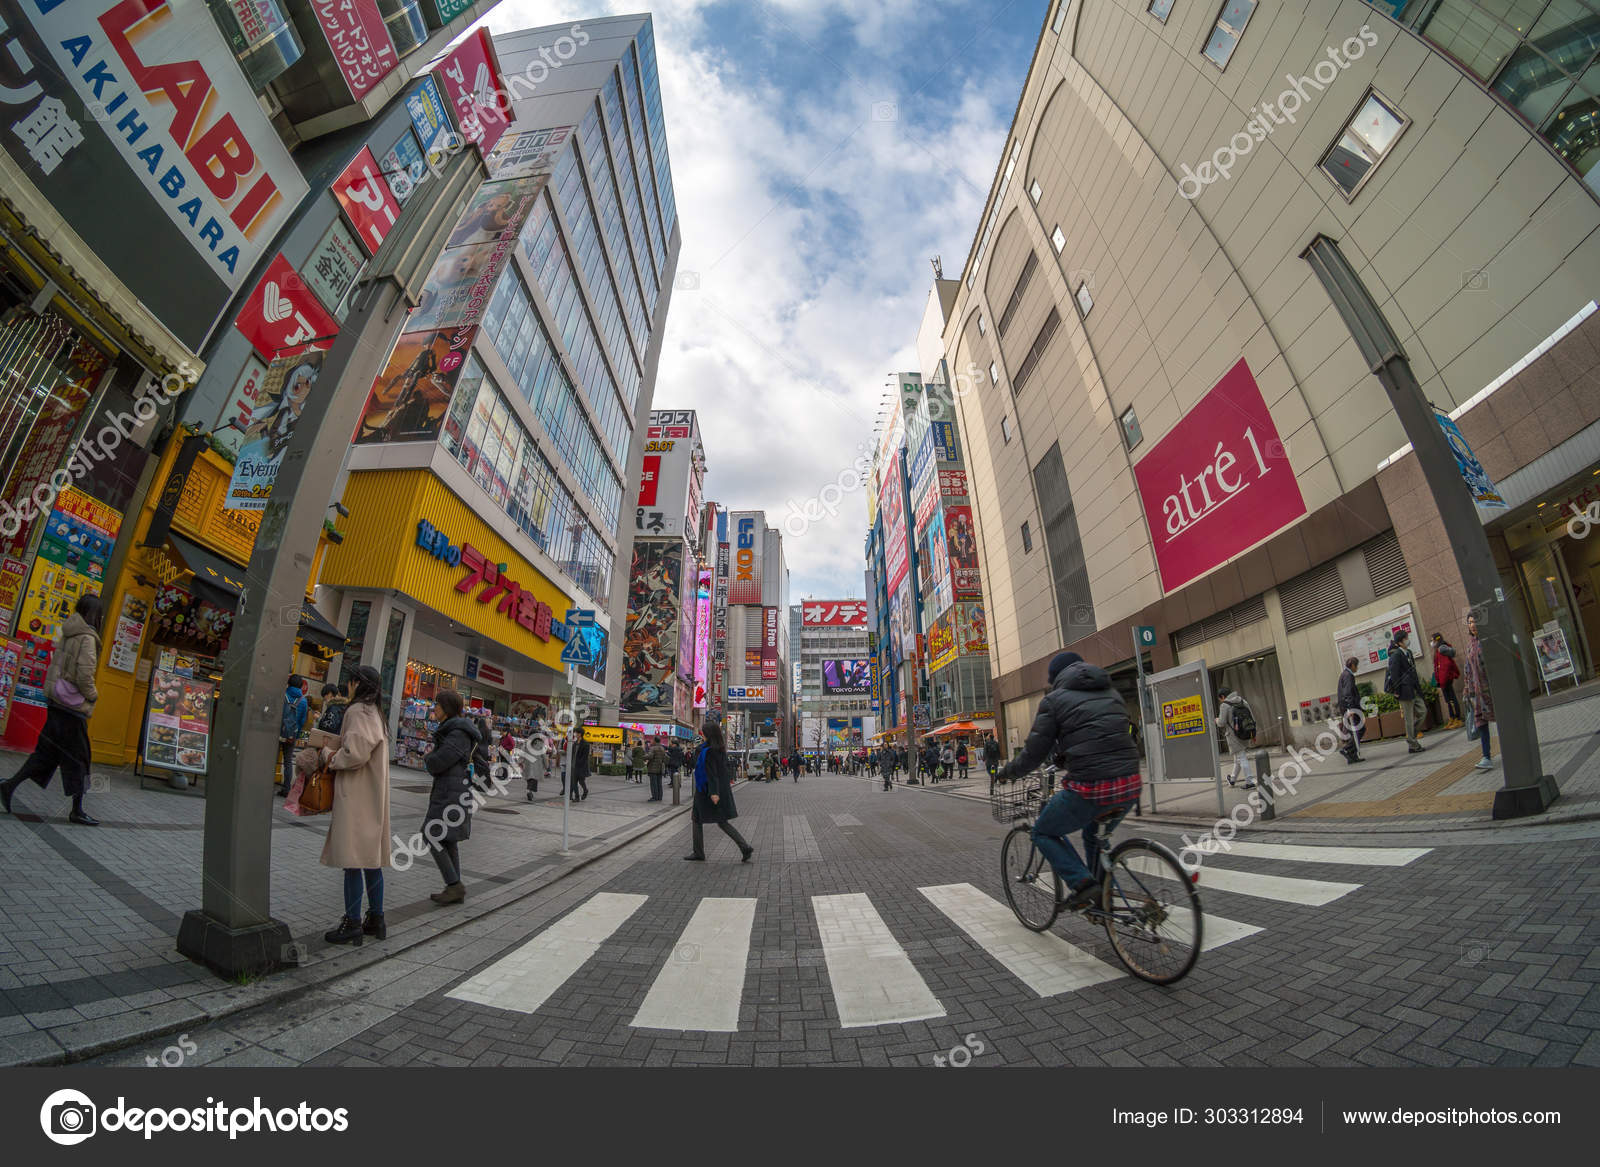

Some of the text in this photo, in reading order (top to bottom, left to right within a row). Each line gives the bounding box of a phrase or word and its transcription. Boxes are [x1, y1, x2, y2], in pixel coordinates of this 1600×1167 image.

[0, 12, 85, 176] ン館
[60, 34, 241, 275] AKIHABARA
[97, 0, 277, 234] LABI
[443, 356, 460, 369] 7F
[1162, 425, 1271, 543] atré 1
